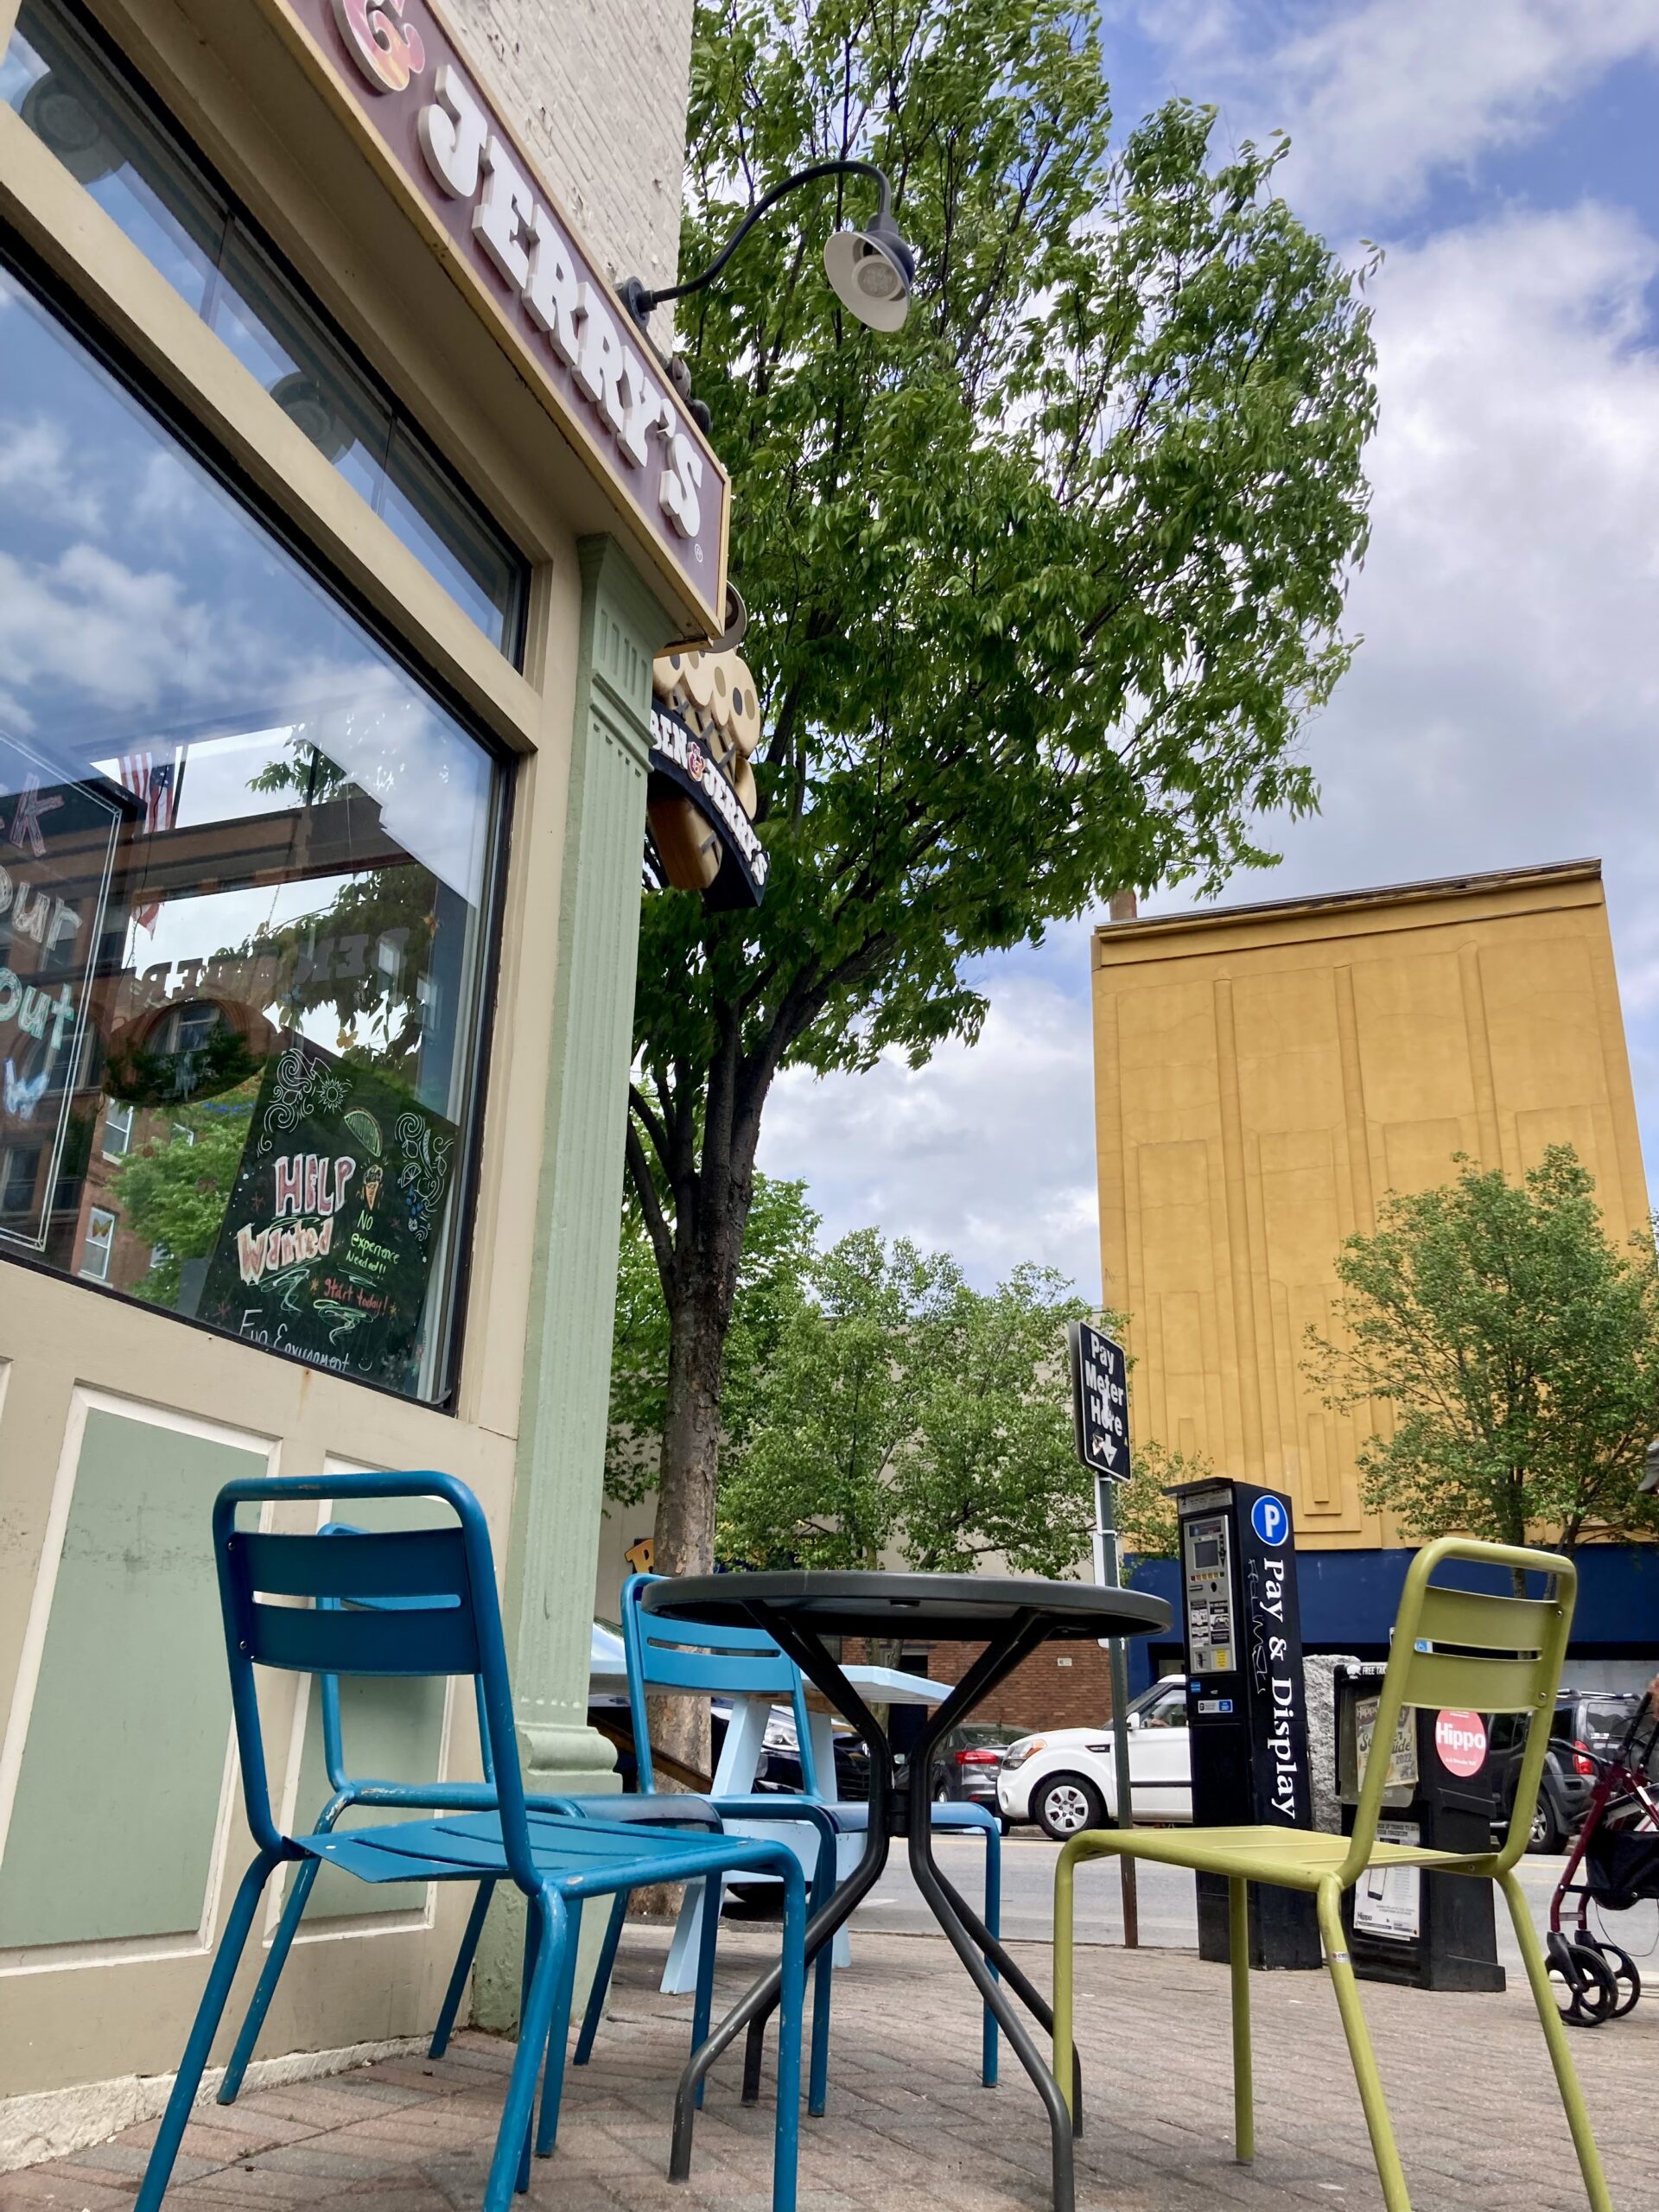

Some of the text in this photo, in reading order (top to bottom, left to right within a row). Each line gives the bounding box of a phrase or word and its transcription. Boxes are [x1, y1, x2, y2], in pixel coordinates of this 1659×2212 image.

[418, 65, 702, 538] JERRY'S
[650, 710, 768, 886] BEN & JERRY'S
[357, 1210, 374, 1230] NO
[236, 1217, 334, 1286] Wanted
[1090, 1332, 1115, 1375] Pay
[1085, 1360, 1123, 1407] Meter
[1264, 1503, 1280, 1537] P
[1363, 1666, 1387, 1675] FREE TAK
[1259, 1558, 1297, 1820] Pay & Display
[1391, 1740, 1412, 1755] uide
[1435, 1722, 1486, 1751] Hippo
[1395, 1754, 1412, 1764] 2022
[1357, 1910, 1373, 1922] Hippo
